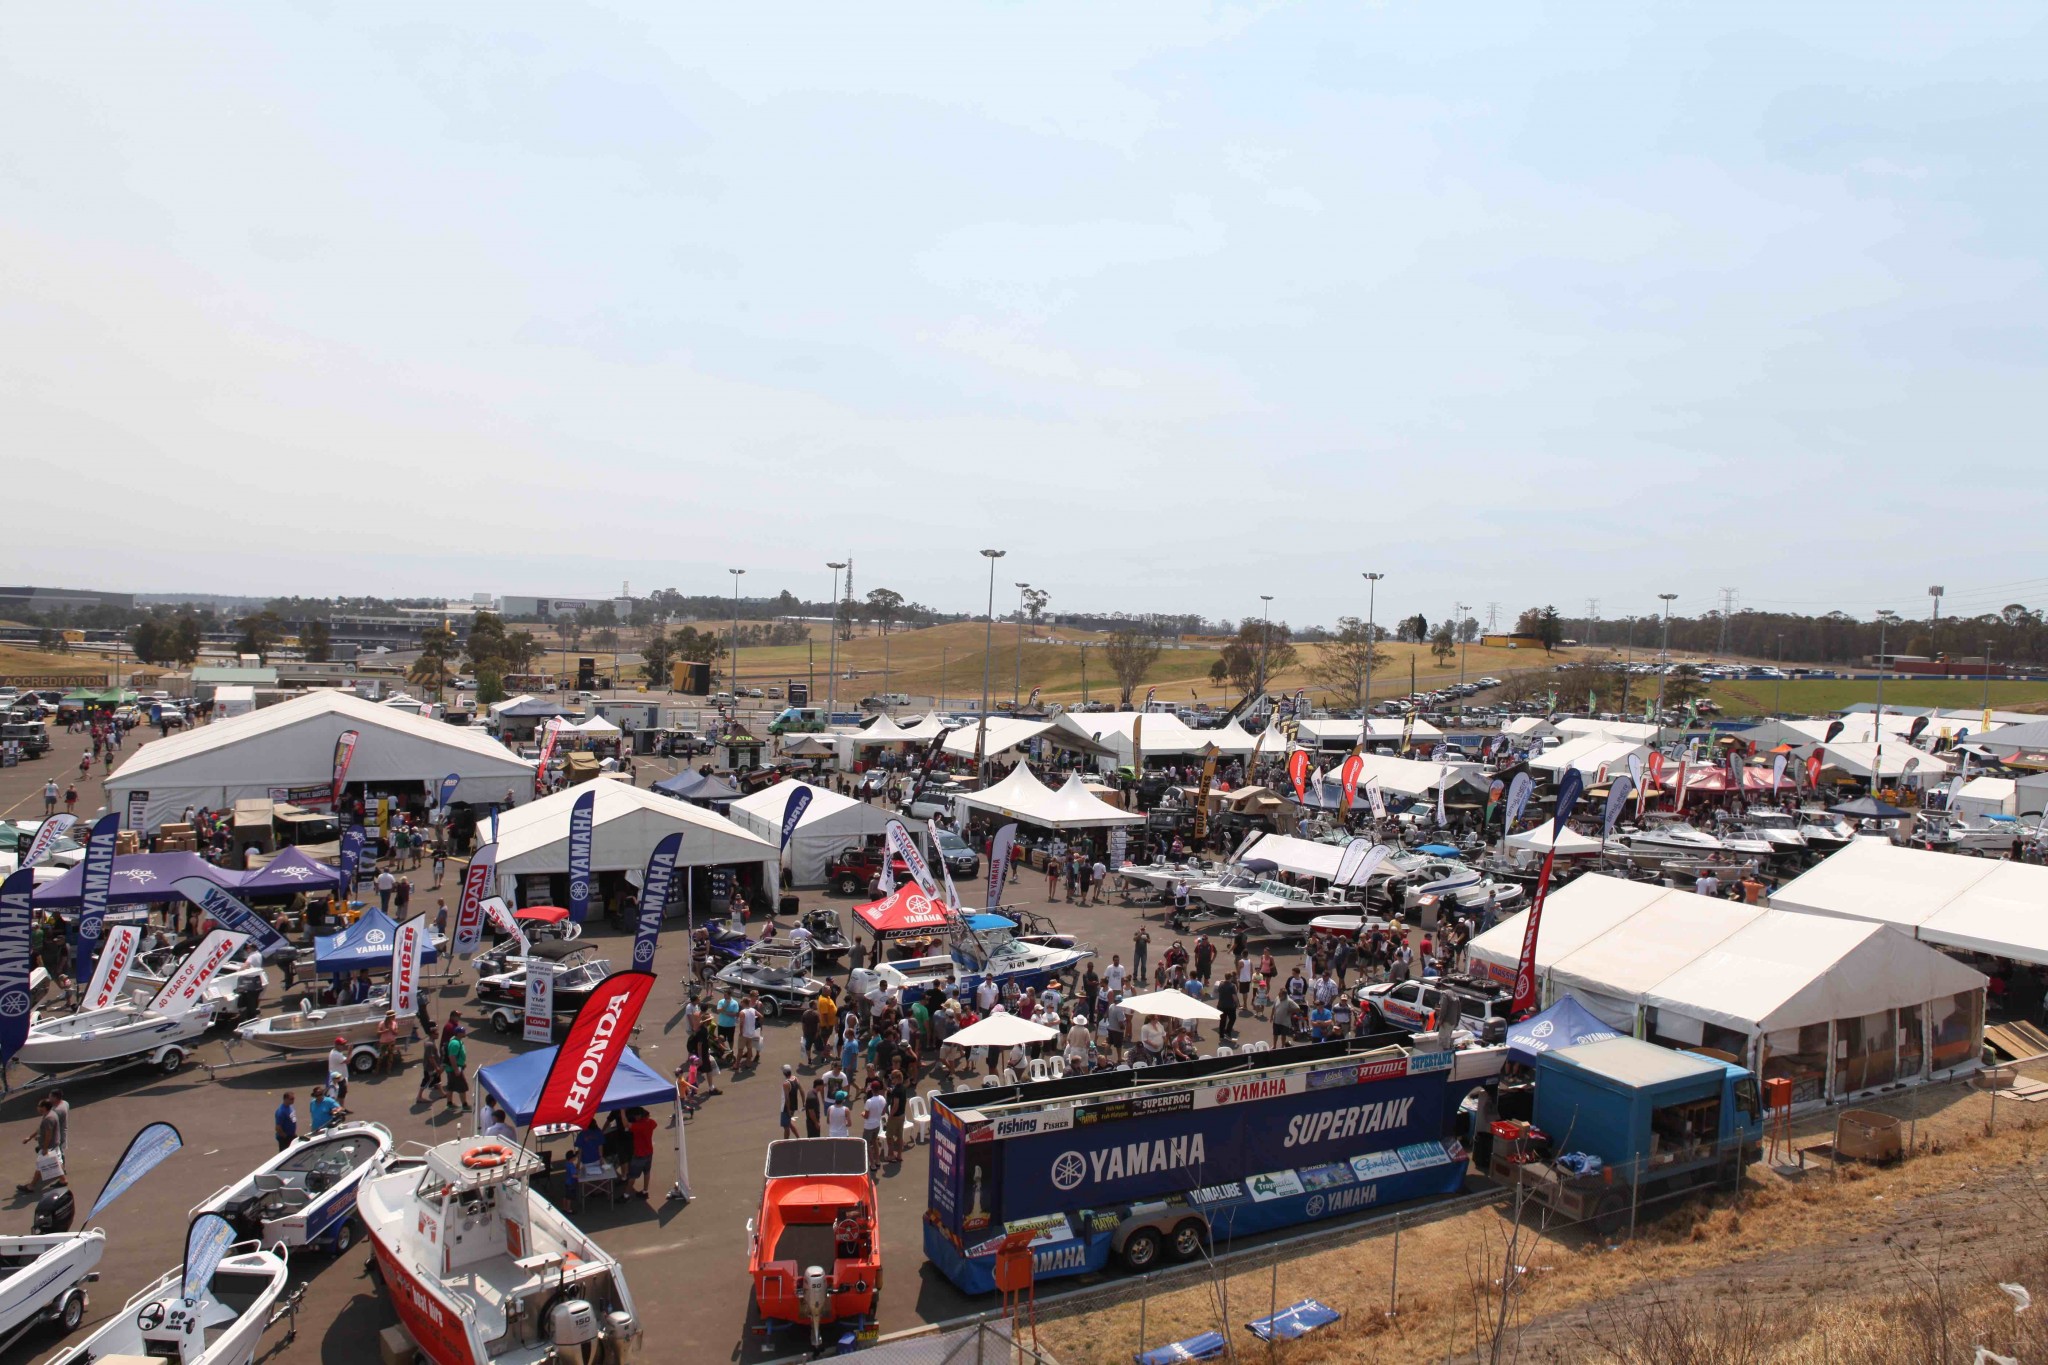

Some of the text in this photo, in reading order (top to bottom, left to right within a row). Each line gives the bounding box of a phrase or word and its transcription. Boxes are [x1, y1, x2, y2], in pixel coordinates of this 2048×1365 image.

[4, 676, 106, 687] ACCREDITATION
[782, 795, 810, 835] NARVA
[1197, 775, 1211, 835] ROOF RACKS
[571, 808, 592, 881] YAMAHA
[83, 833, 115, 917] YAMAHA
[990, 858, 1001, 889] YAMAHA
[463, 868, 485, 923] LOAN
[640, 853, 676, 939] YAMAHA
[904, 913, 942, 924] YAMAHA
[0, 893, 30, 988] YAMAHA
[356, 943, 393, 954] YAMAH
[97, 929, 132, 1008] STACER
[183, 939, 233, 999] STACER
[399, 927, 414, 1010] STACER
[530, 1018, 546, 1026] LOAN
[564, 991, 630, 1115] HONDA
[1512, 1035, 1549, 1052] YAMAHA
[1360, 1059, 1405, 1077] ATOMIC
[1411, 1052, 1452, 1070] SUPERTANK
[1142, 1093, 1191, 1109] SUPERFROG
[1232, 1078, 1287, 1102] YAMAHA
[997, 1118, 1037, 1135] fishing
[1043, 1121, 1069, 1131] FISHER
[1284, 1097, 1415, 1148] SUPERTANK
[1089, 1133, 1206, 1183] YAMAHA
[1328, 1184, 1377, 1212] YAMAHA
[1033, 1245, 1086, 1273] AMAHA
[412, 1285, 444, 1329] boat hire
[575, 1316, 591, 1326] 150
